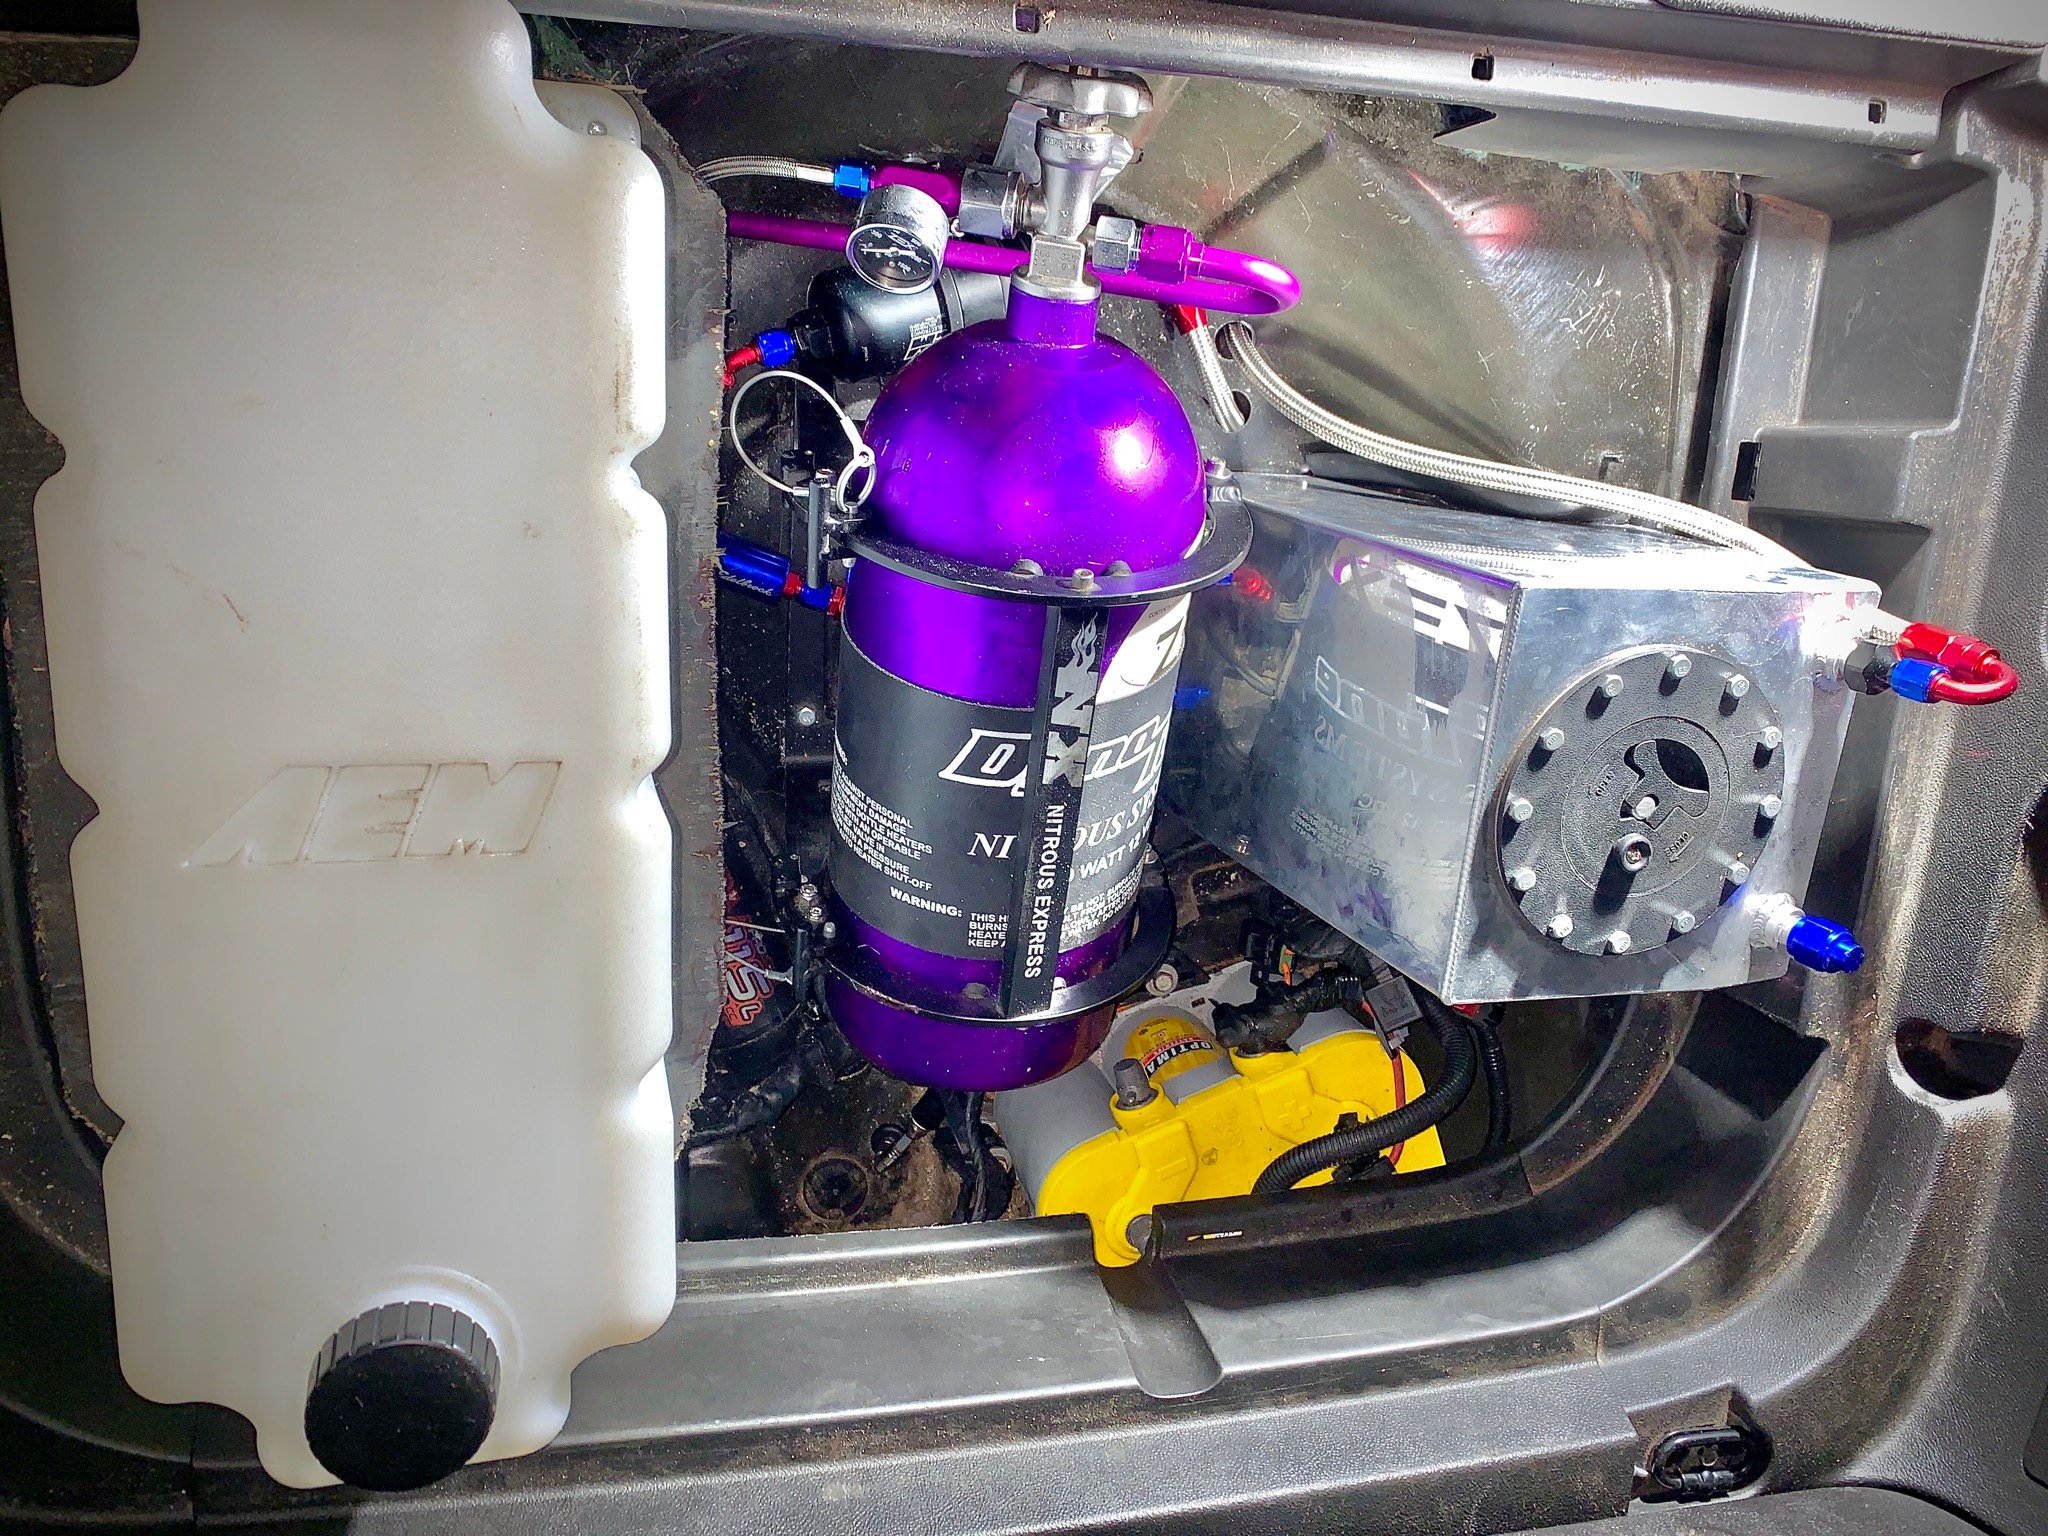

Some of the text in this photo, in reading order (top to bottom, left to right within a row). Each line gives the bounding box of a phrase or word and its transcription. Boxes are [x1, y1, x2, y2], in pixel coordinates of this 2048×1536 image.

[1594, 770, 1616, 797] OPEN
[179, 761, 563, 867] AEM
[866, 796, 914, 829] PERSONAL
[868, 809, 907, 836] DAMAGE
[853, 822, 875, 849] VALVE
[875, 841, 886, 854] IN
[871, 828, 921, 861] OPERABLE
[886, 826, 933, 855] HEATERS
[853, 843, 883, 872] HEATER
[883, 865, 933, 891] SHUT-OFF
[864, 841, 911, 876] PRESSURE
[1080, 845, 1127, 879] WATT
[890, 886, 963, 917] WARNING:
[1024, 804, 1067, 978] NITROUS EXPRESS
[969, 921, 1008, 932] BURNS
[970, 912, 996, 923] THIS
[967, 938, 999, 948] KEEP
[1146, 1040, 1212, 1074] OPTIMA
